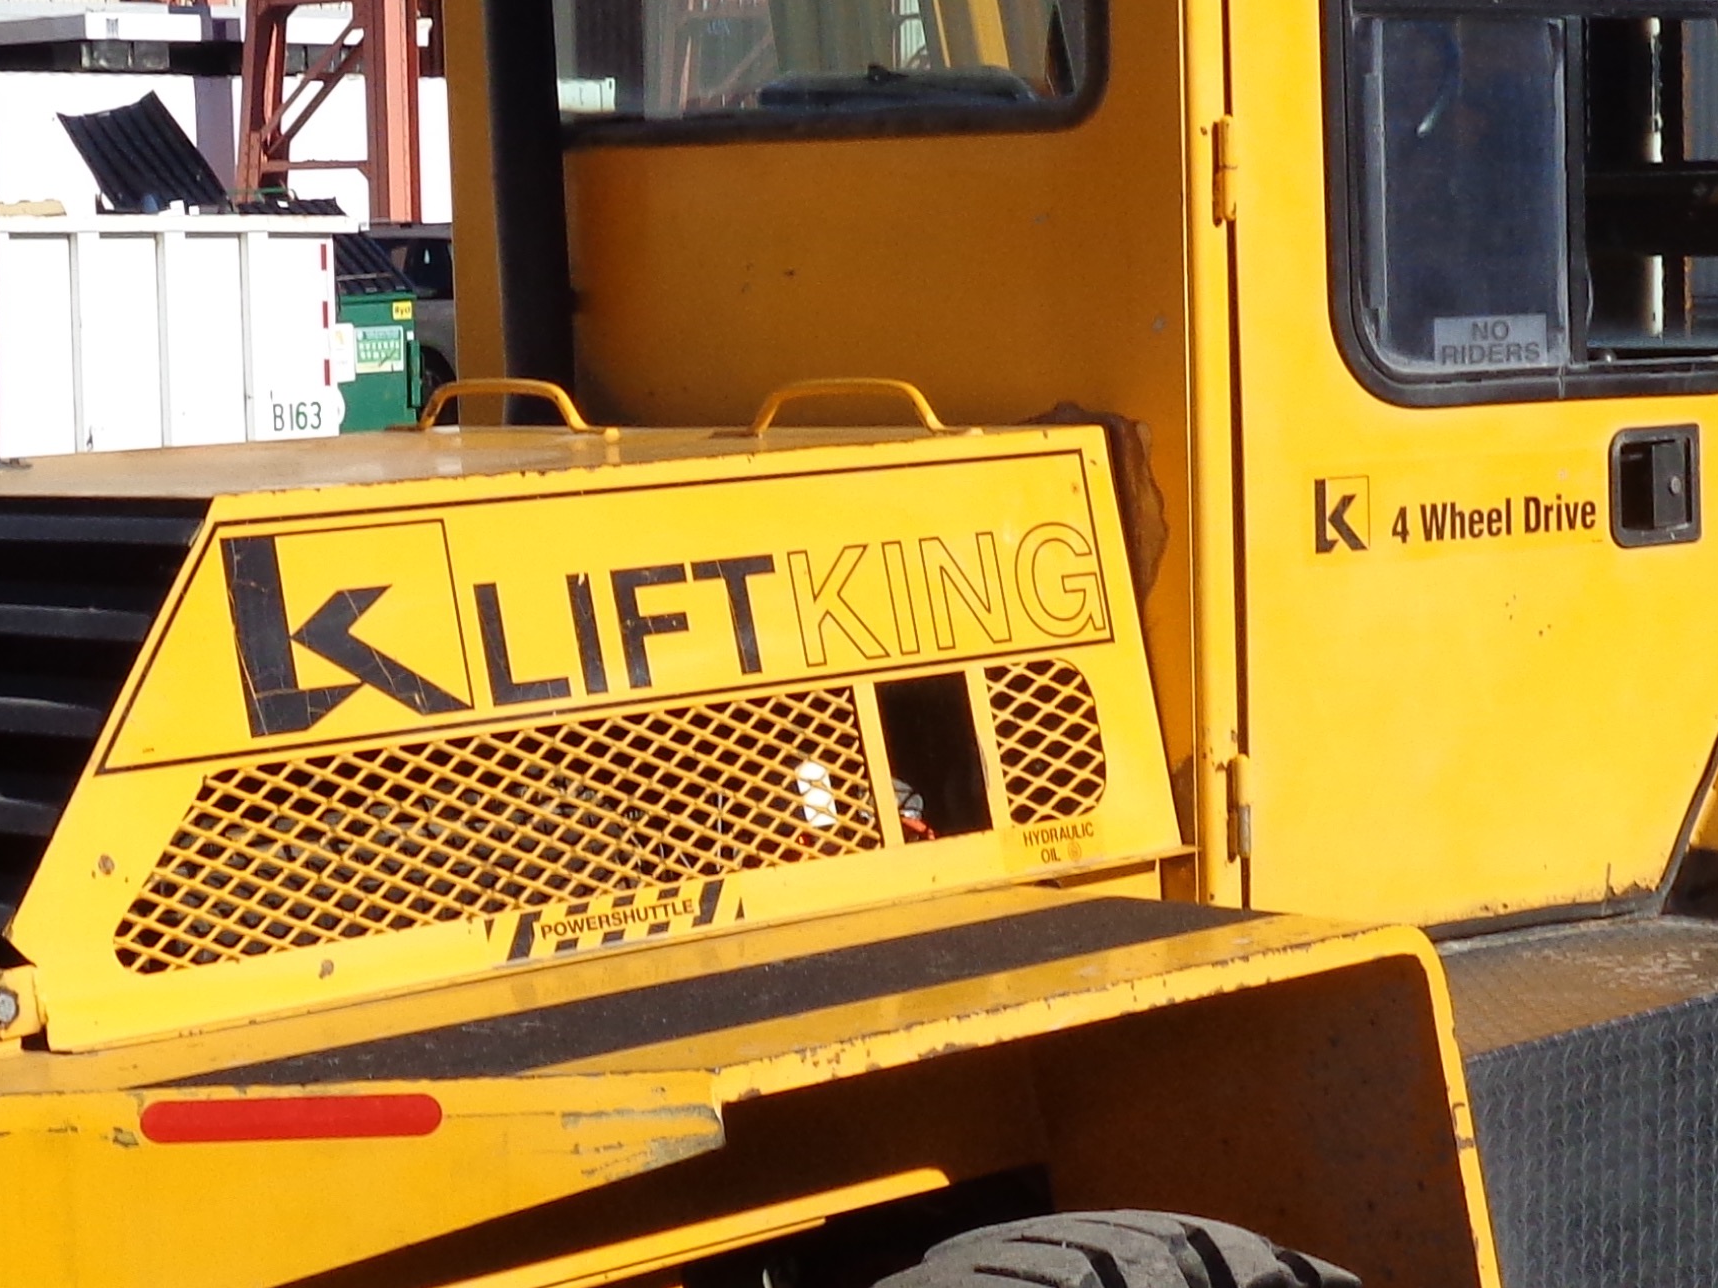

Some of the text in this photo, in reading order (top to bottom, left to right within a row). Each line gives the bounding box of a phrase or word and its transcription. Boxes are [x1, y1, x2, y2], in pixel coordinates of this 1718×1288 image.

[1471, 319, 1509, 341] NO
[1441, 342, 1541, 365] RIDERS
[272, 401, 322, 431] B163
[1314, 478, 1597, 554] K 4 Wheel Drive
[219, 535, 476, 739] K
[1023, 821, 1095, 847] HYDRAULIC
[1040, 847, 1062, 864] OIL
[540, 898, 695, 940] POWERSHUTTLE
